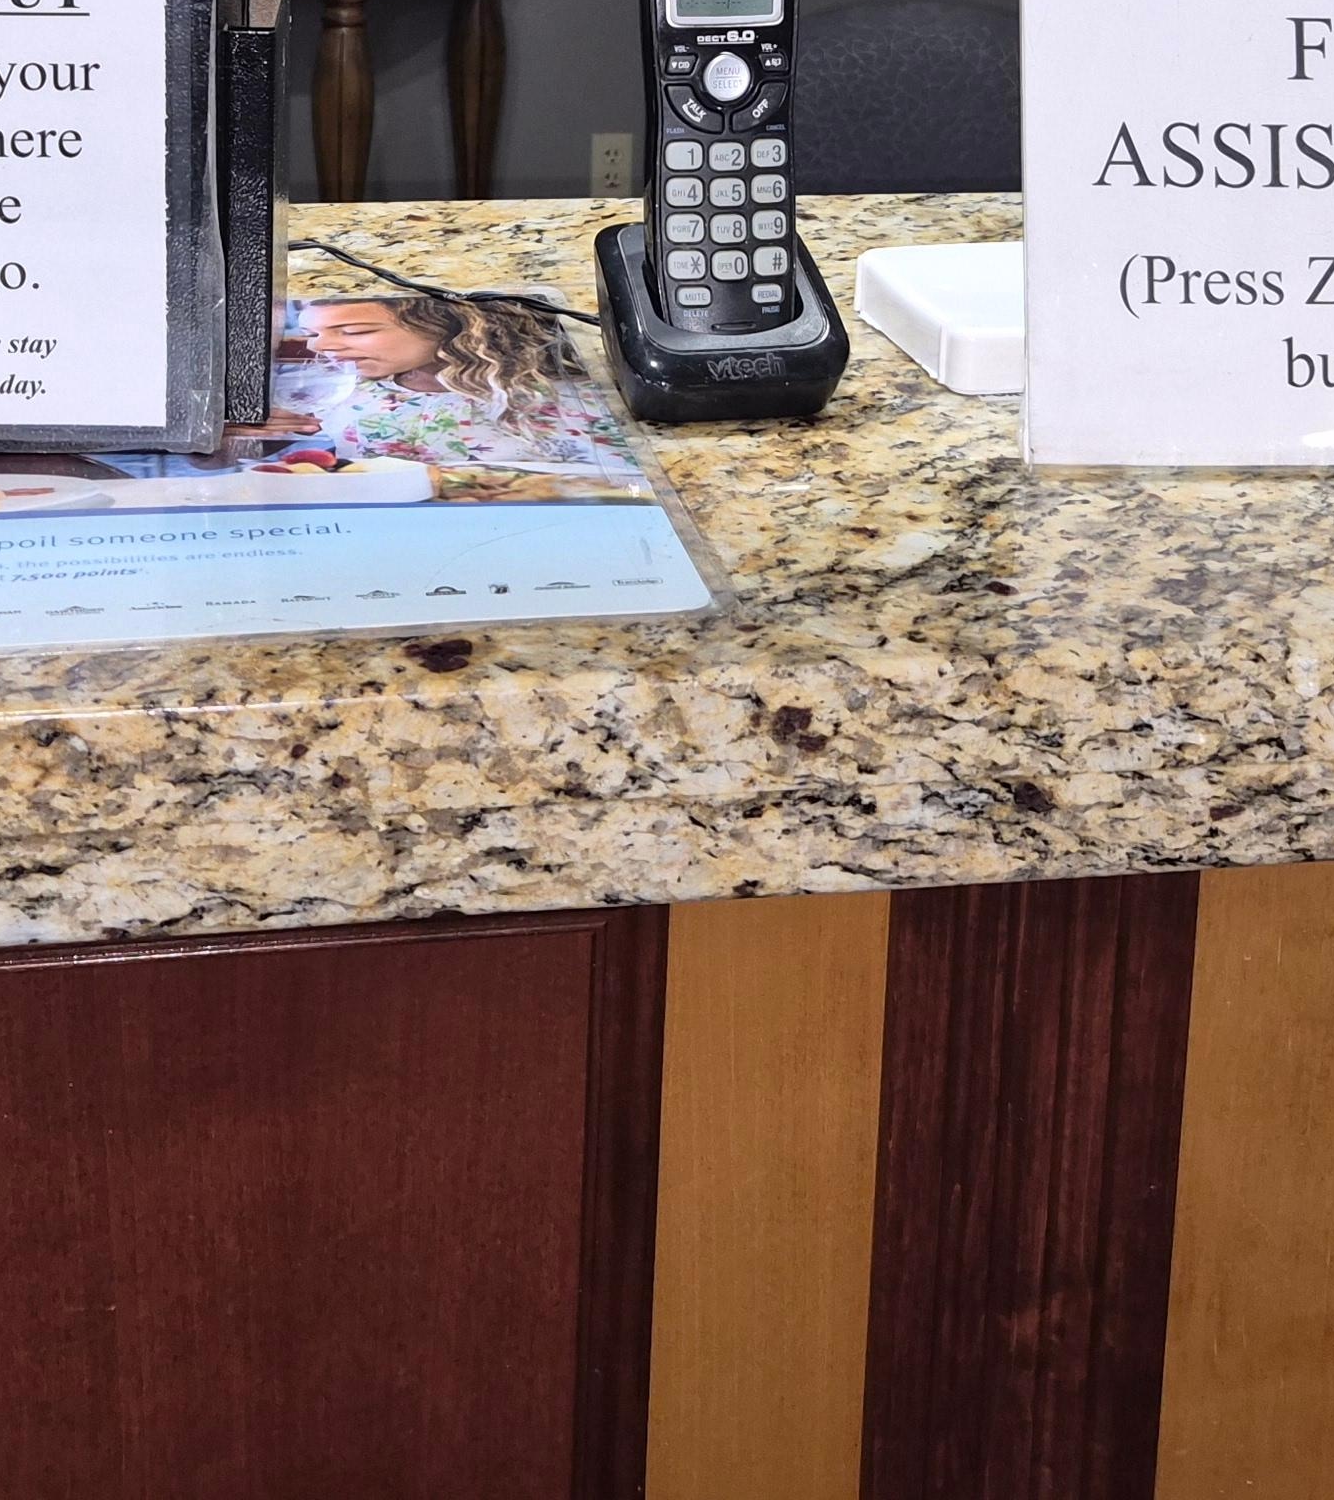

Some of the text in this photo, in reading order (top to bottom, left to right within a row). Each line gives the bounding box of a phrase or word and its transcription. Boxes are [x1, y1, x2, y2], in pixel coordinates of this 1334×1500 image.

[715, 66, 741, 76] MENU
[712, 79, 743, 90] SELECT
[685, 97, 707, 118] TALK
[751, 98, 770, 119] OFF
[687, 147, 695, 167] 1
[731, 148, 742, 167] 2
[772, 144, 783, 163] 3
[687, 183, 699, 203] 4
[731, 183, 743, 202] 5
[772, 180, 783, 199] 6
[688, 219, 700, 238] 7
[732, 220, 744, 239] 8
[773, 216, 785, 235] 9
[734, 256, 745, 275] 0
[1120, 255, 1284, 318] (Press
[684, 291, 707, 302] MUTE
[8, 337, 56, 359] stay
[706, 352, 786, 381] vtech
[0, 374, 45, 399] day.
[69, 529, 219, 547] someone
[229, 521, 352, 541] special.
[18, 558, 50, 569] the
[56, 553, 179, 570] possibilities
[185, 551, 216, 562] are
